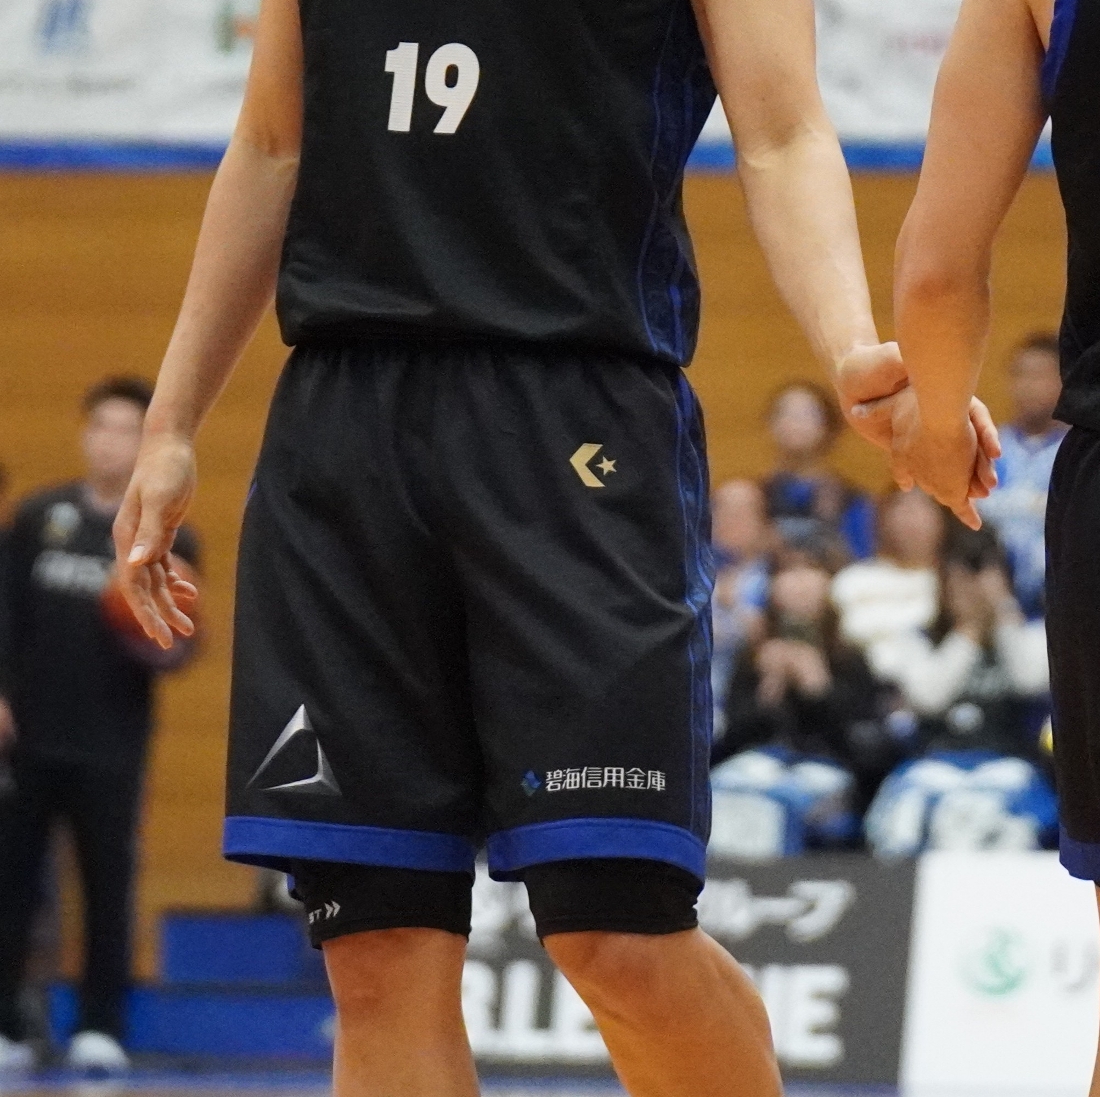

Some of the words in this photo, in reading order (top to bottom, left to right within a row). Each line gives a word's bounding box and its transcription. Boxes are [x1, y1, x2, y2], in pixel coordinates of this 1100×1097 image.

[385, 42, 480, 133] 19
[545, 766, 666, 792] 碧海信用金庫
